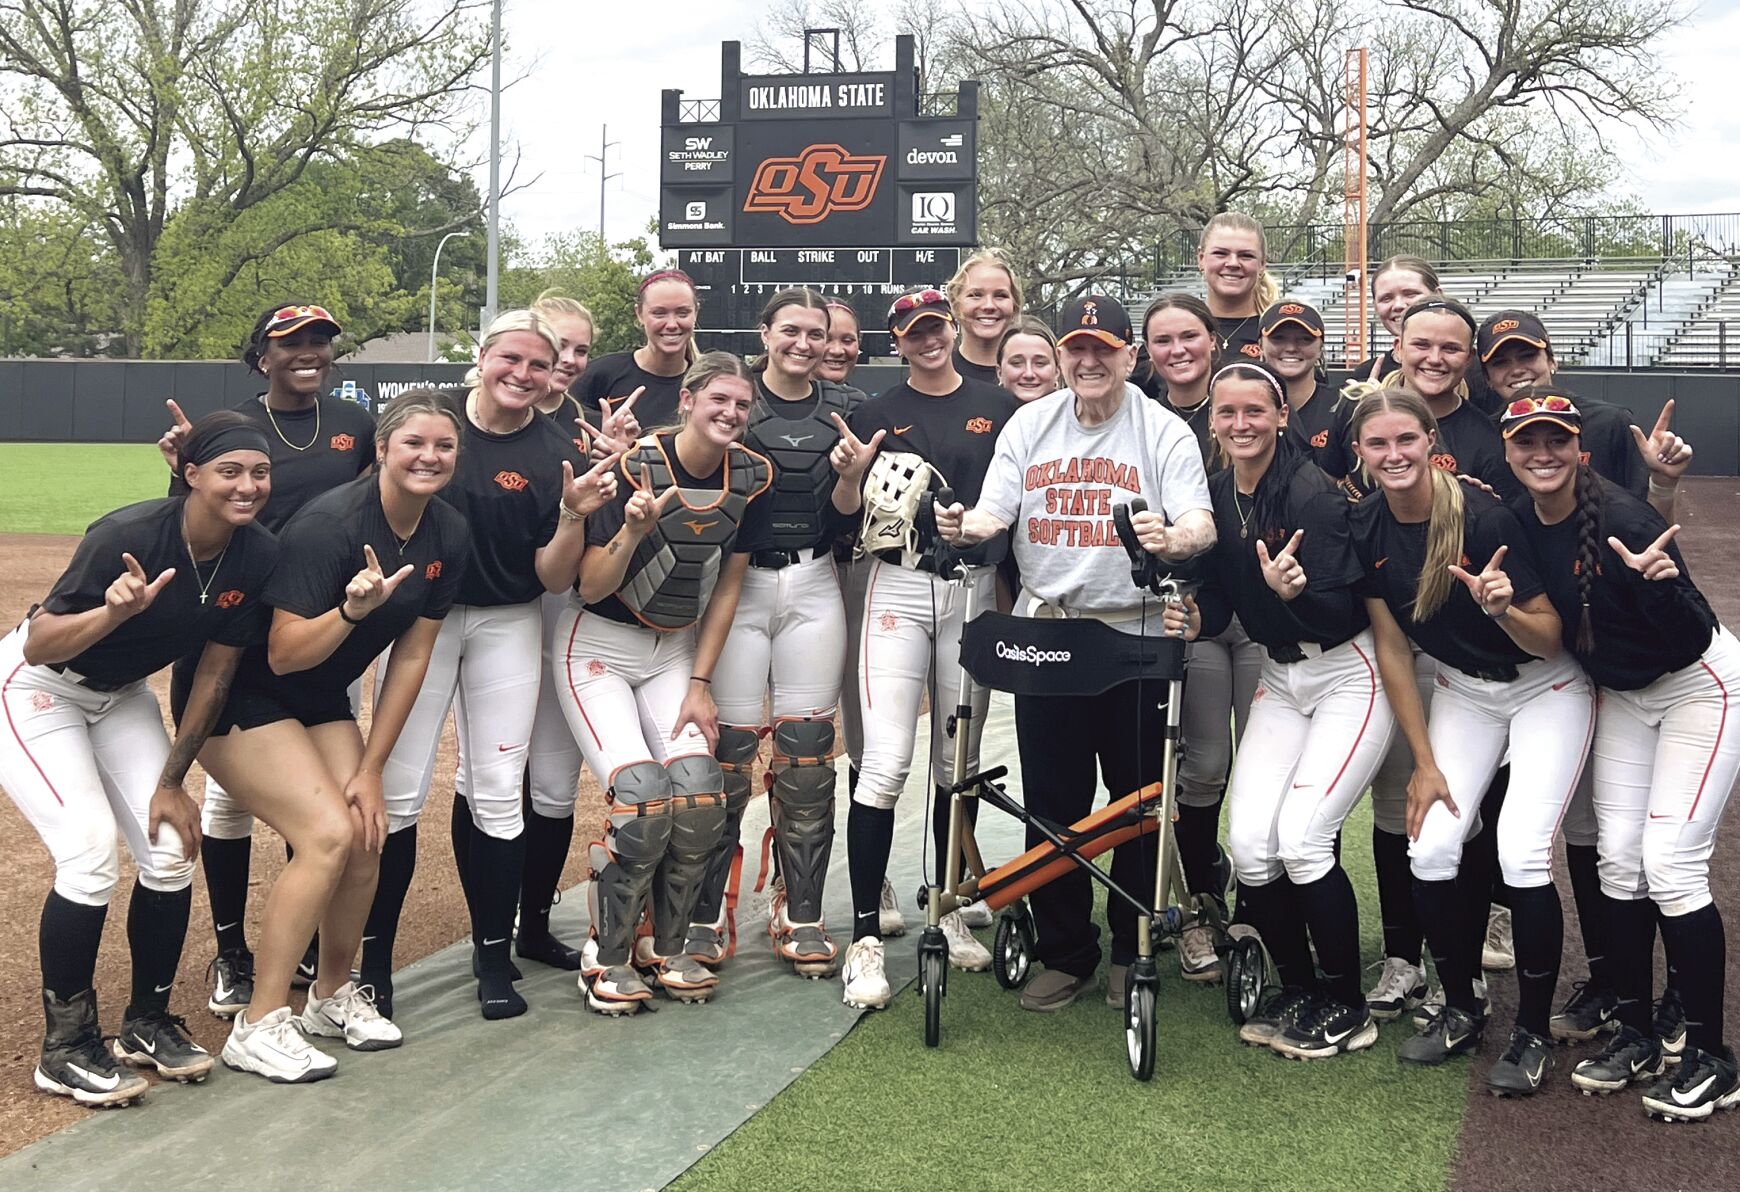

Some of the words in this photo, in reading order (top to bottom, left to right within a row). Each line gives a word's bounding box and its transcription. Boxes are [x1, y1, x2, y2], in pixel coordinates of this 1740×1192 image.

[749, 85, 832, 109] OKLAHOMA
[838, 83, 885, 107] STATE
[685, 137, 713, 151] SW
[668, 151, 692, 160] SETH
[692, 151, 729, 160] WADLEY
[906, 148, 958, 164] devon
[684, 162, 712, 171] PERRY
[743, 143, 888, 224] OSU
[919, 196, 950, 221] IQ
[667, 222, 703, 230] Simmons
[911, 226, 929, 234] CAR
[689, 251, 703, 263] AT
[705, 251, 726, 263] BAT
[750, 251, 777, 263] BALL
[797, 251, 835, 263] STRIKE
[857, 250, 880, 263] OUT
[915, 250, 935, 264] H/E
[731, 284, 736, 294] 1
[743, 284, 750, 294] 2
[757, 284, 763, 294] 3
[774, 284, 780, 294] 4
[820, 284, 826, 294] 7
[833, 284, 839, 294] 8
[846, 284, 853, 294] 9
[862, 284, 873, 294] 10
[880, 284, 905, 295] RUNS
[1278, 303, 1305, 315] OSU
[1492, 319, 1520, 335] OSU
[1240, 343, 1264, 358] OS
[965, 416, 993, 434] OSU
[330, 433, 356, 451] OSU
[1310, 429, 1329, 448] OS
[494, 470, 529, 492] OSU
[1025, 457, 1142, 495] OKLAHOMA
[1045, 487, 1112, 516] STATE
[1027, 517, 1124, 548] SOFTBAL
[995, 640, 1072, 667] OasisSpace
